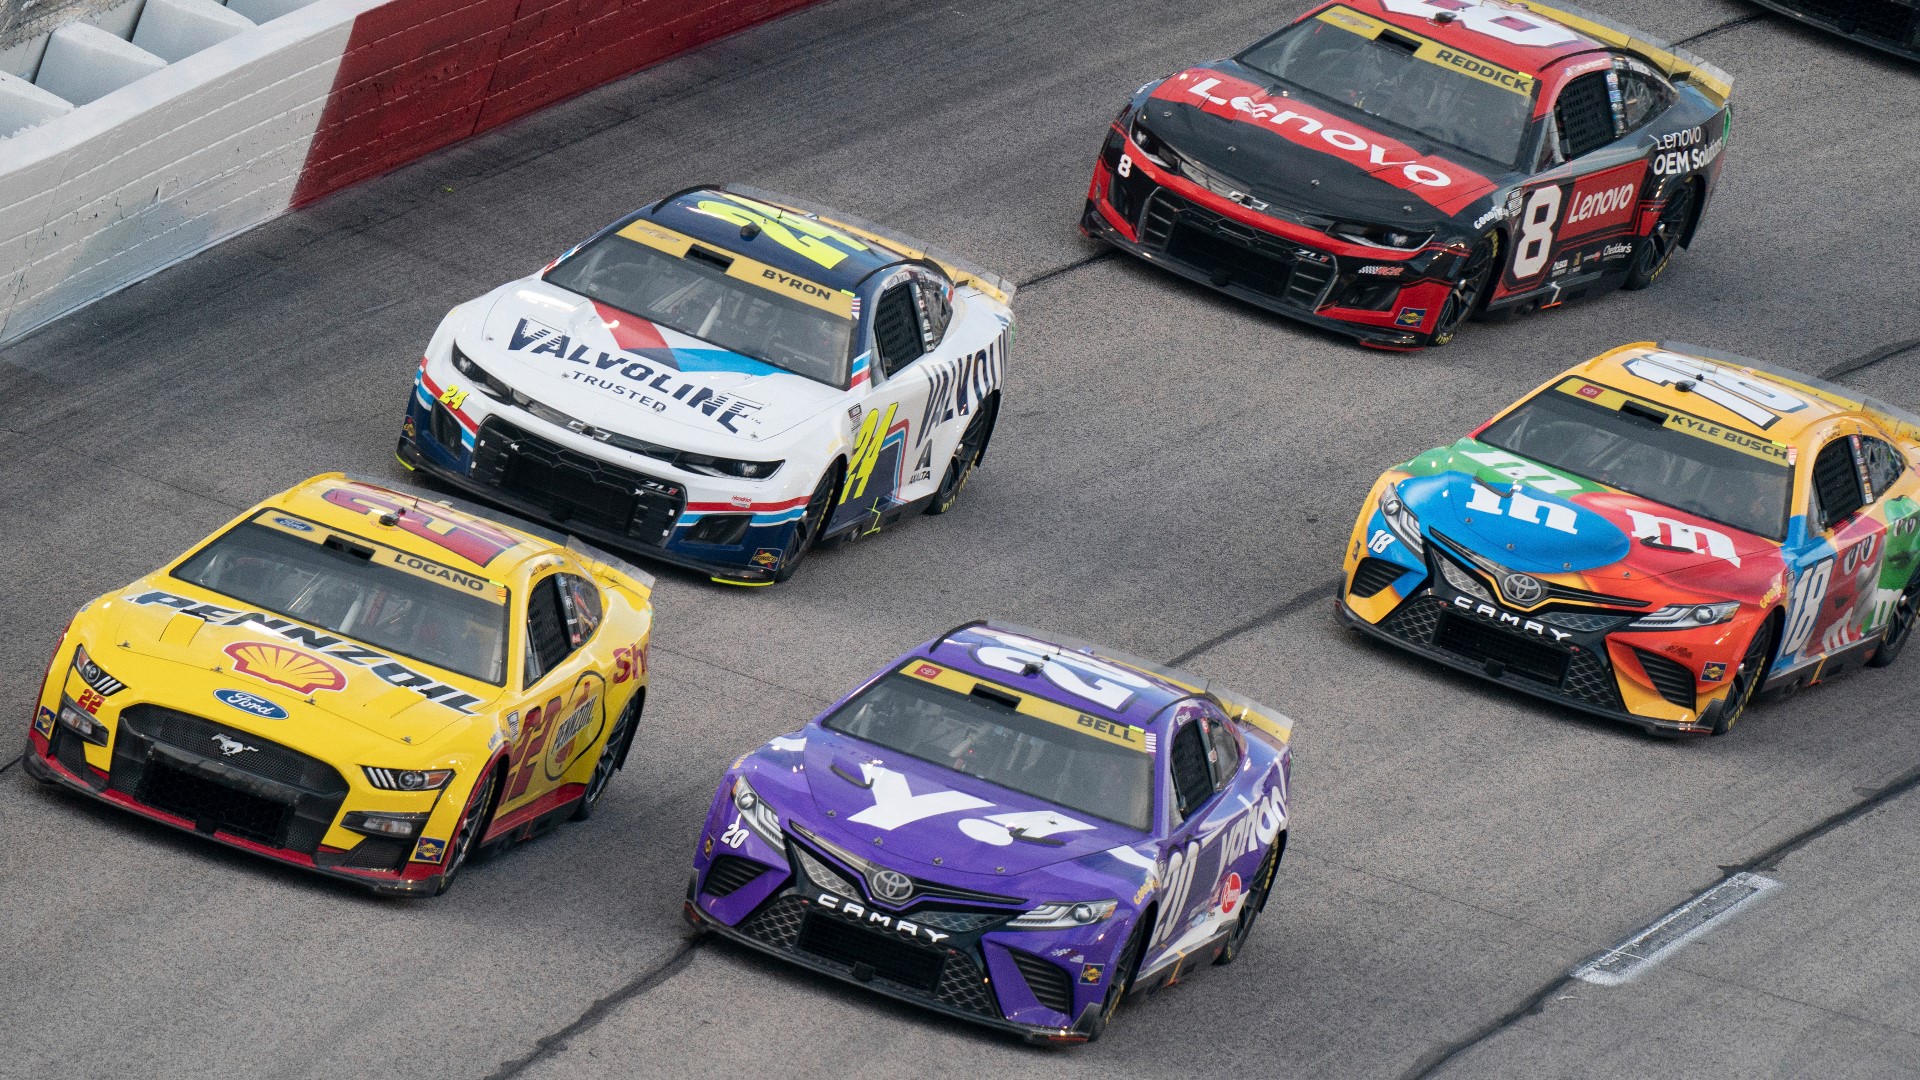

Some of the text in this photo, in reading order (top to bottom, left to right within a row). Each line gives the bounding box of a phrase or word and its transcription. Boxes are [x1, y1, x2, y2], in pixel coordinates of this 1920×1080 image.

[1435, 48, 1530, 93] REDDICK
[1187, 77, 1452, 187] Lenovo
[1648, 127, 1701, 152] Lenovo
[1117, 153, 1132, 178] 8
[1653, 149, 1693, 176] OEM
[1567, 182, 1635, 224] Lenovo
[1512, 184, 1562, 279] 8
[761, 268, 832, 302] BYRON
[507, 317, 765, 434] VALVOLINE
[572, 369, 668, 413] TRUSTED
[439, 384, 470, 410] 24
[838, 402, 899, 506] 24
[1671, 413, 1789, 459] KYLE BUSCH
[1367, 528, 1396, 554] 18
[394, 553, 485, 592] LOGANO
[1453, 594, 1573, 642] CAMRY
[1783, 557, 1835, 656] 18
[120, 589, 487, 717] PENNZOIL
[76, 688, 105, 715] 22
[225, 690, 273, 716] Ford
[1075, 713, 1137, 743] BELL
[721, 823, 750, 850] 20
[817, 893, 950, 943] CAMRY
